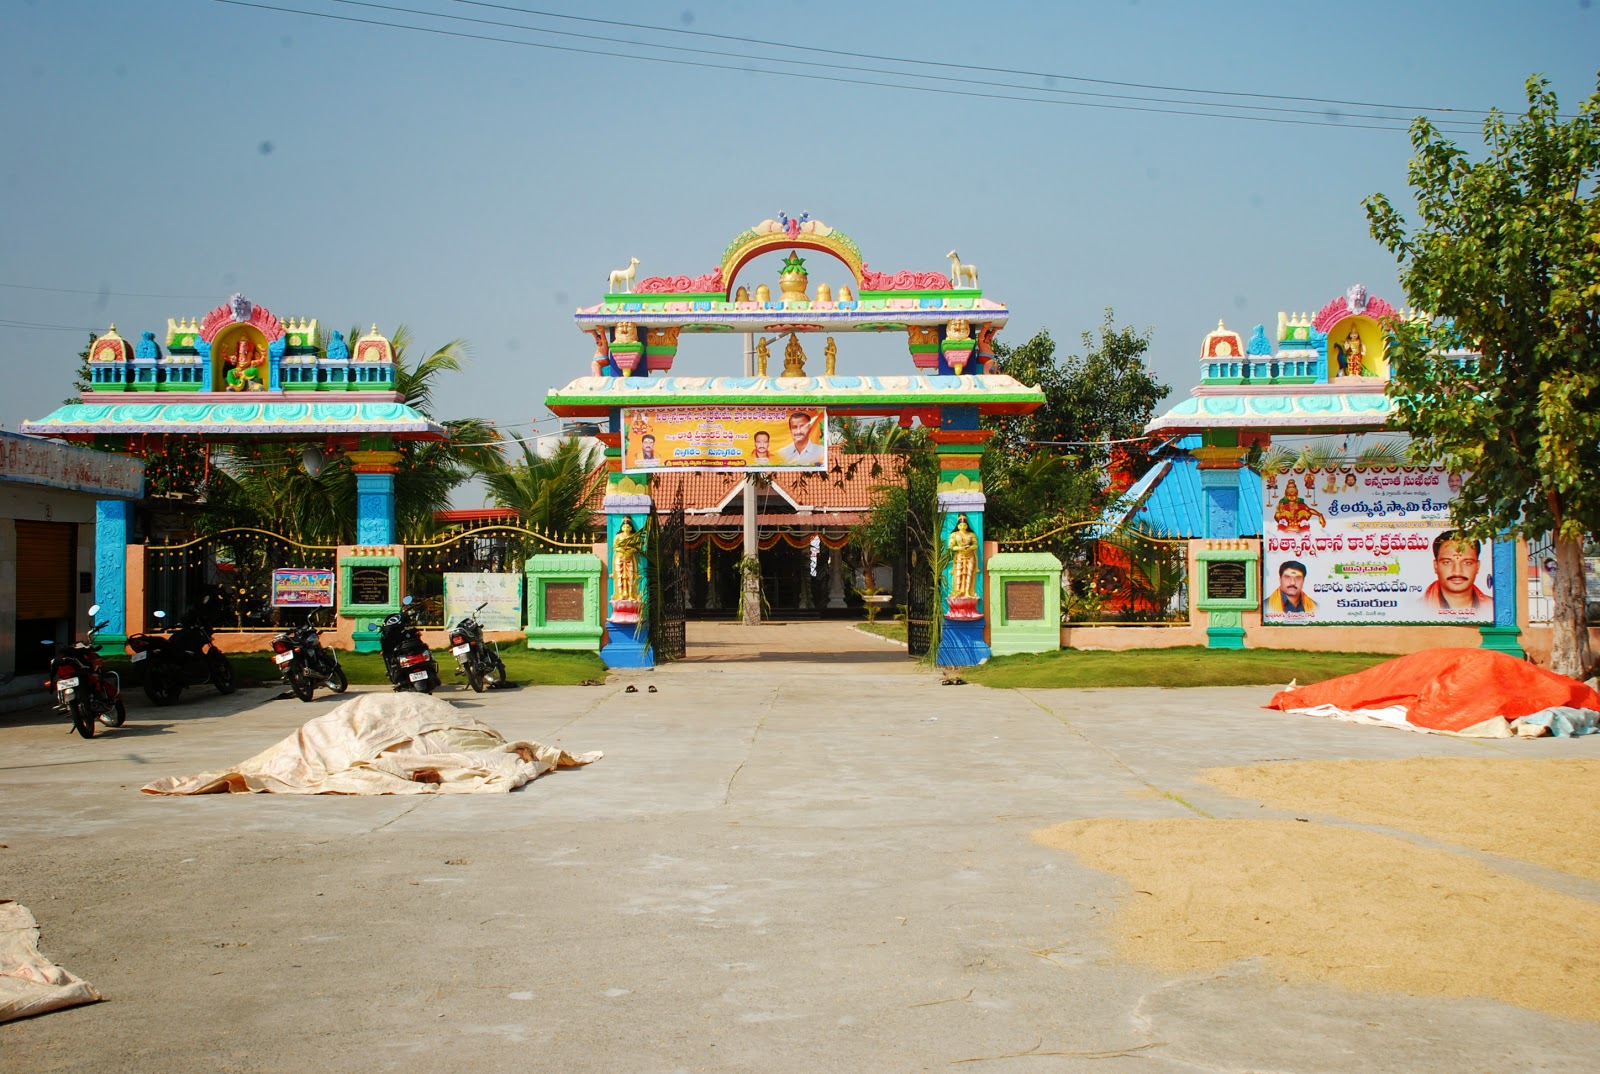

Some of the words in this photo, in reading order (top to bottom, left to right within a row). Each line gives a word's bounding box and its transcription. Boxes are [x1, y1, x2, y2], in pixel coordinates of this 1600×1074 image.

[1364, 475, 1401, 489] అన్నదాత
[1403, 474, 1440, 488] సుఖీభవ
[1328, 499, 1339, 516] శ్రీ
[1340, 500, 1386, 517] అయ్యప్ప
[1386, 501, 1420, 516] స్వామి
[1268, 533, 1344, 557] నిత్యాన్నదాన
[1347, 533, 1429, 556] కార్యక్రమము
[1313, 582, 1343, 593] బజారు
[1345, 579, 1408, 593] అనసూయదేవి
[1336, 598, 1398, 608] కుమారులు
